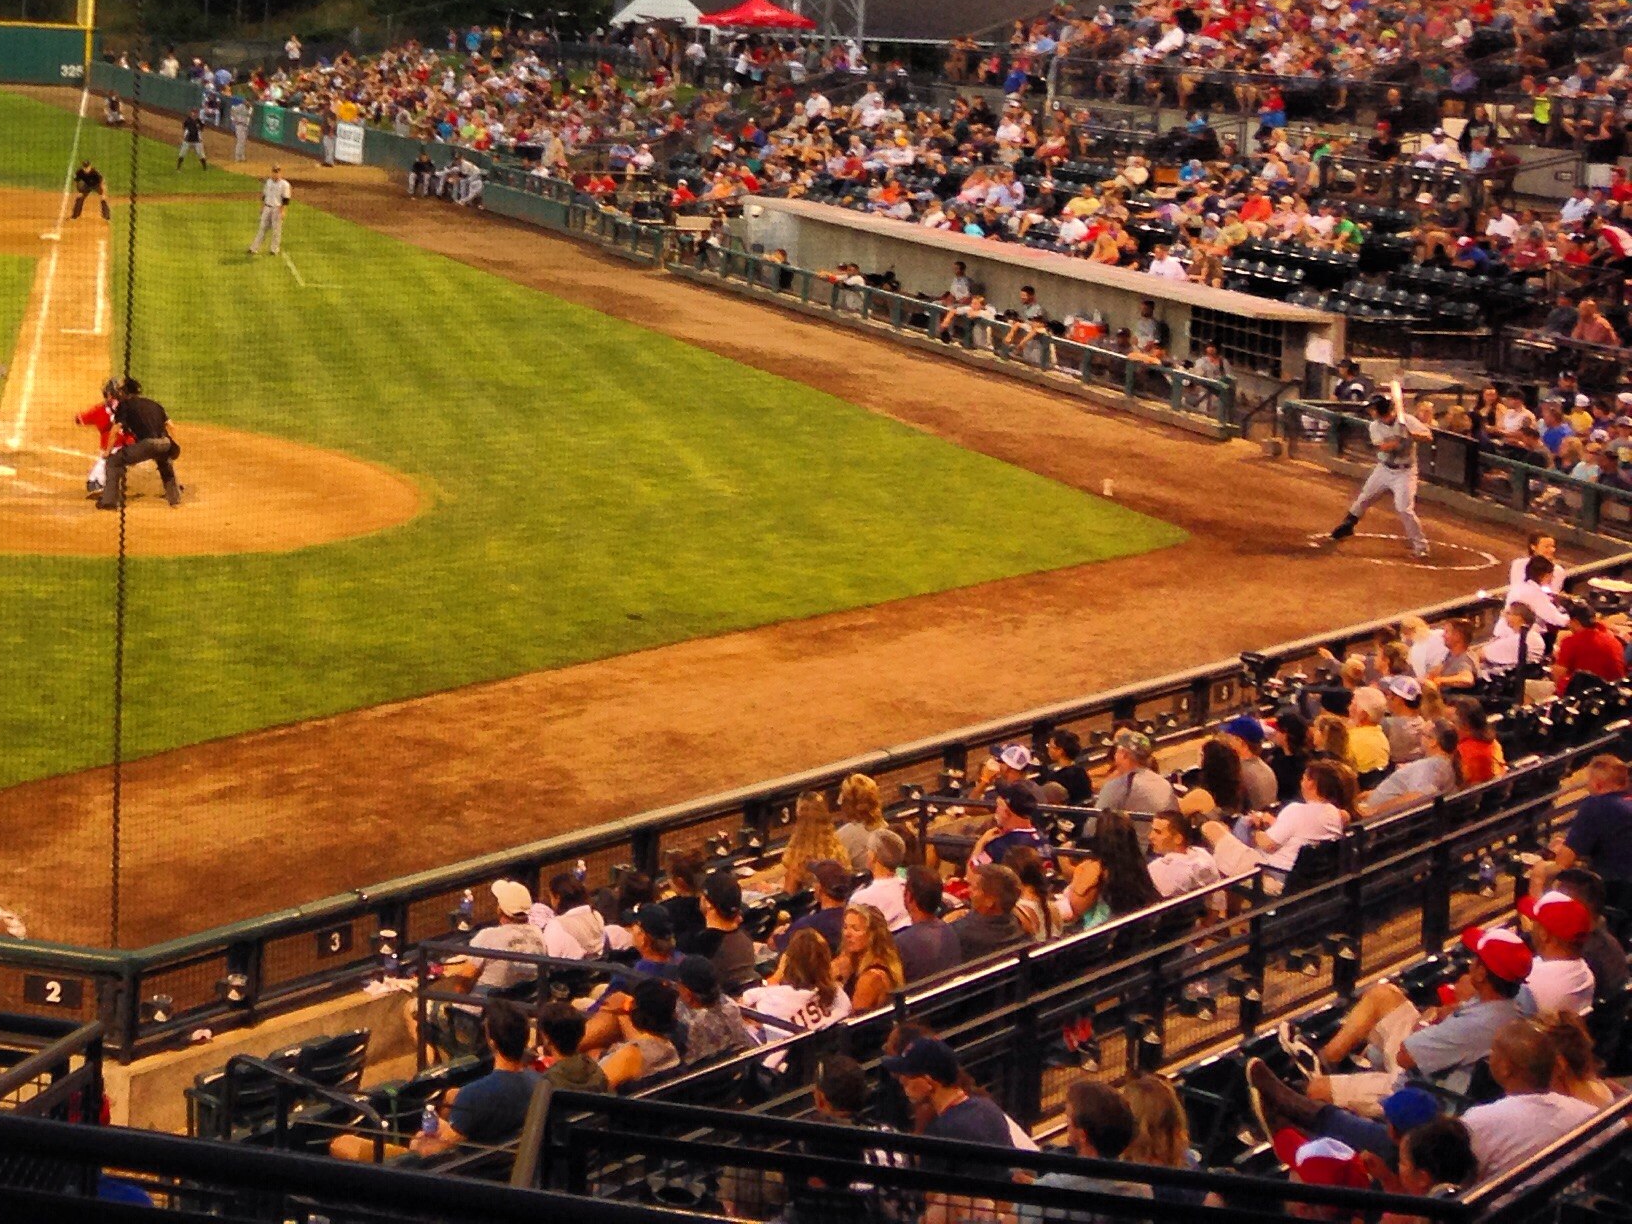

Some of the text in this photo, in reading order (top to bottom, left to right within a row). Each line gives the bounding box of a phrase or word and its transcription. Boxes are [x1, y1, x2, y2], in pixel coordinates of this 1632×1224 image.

[780, 806, 790, 824] 3
[330, 932, 341, 952] 3
[46, 981, 61, 1003] 2
